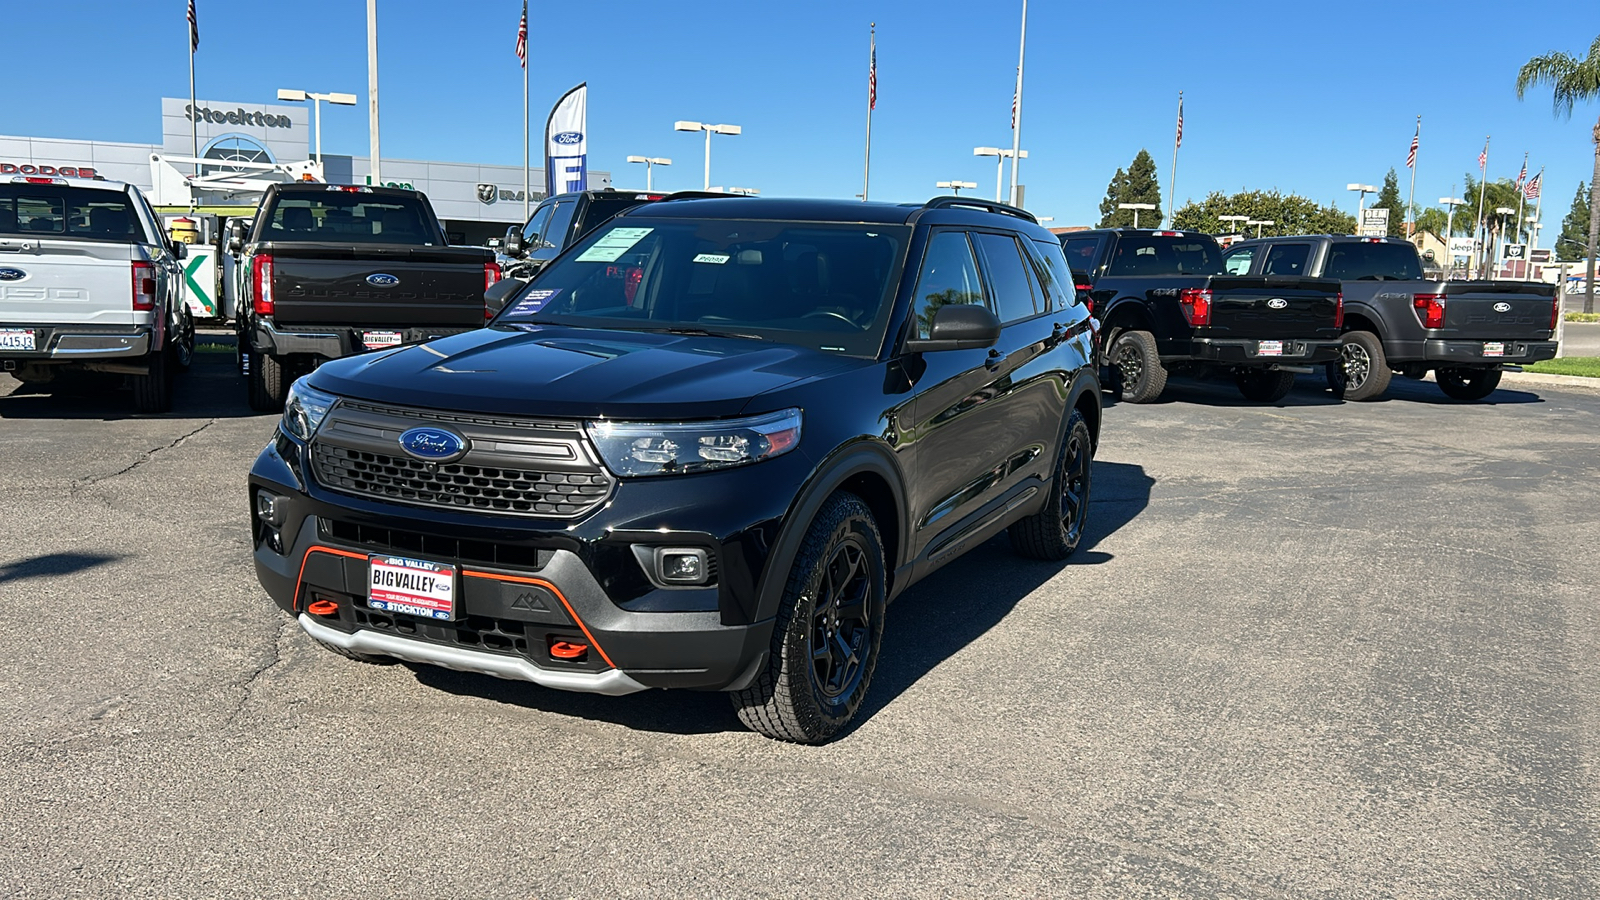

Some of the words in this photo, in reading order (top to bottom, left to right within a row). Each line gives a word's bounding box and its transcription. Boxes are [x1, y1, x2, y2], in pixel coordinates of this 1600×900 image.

[185, 104, 292, 129] Stockton
[558, 133, 580, 144] Ford
[0, 163, 97, 178] DODGE
[1365, 210, 1386, 218] OEM
[1451, 244, 1472, 252] Jeep
[286, 289, 392, 299] SUPER
[0, 336, 33, 347] 415J3
[411, 432, 448, 453] Ford
[388, 557, 404, 566] BIG
[405, 560, 434, 571] VALLEY
[373, 569, 435, 593] BIGVALLEY
[387, 601, 434, 618] STOCKTON
